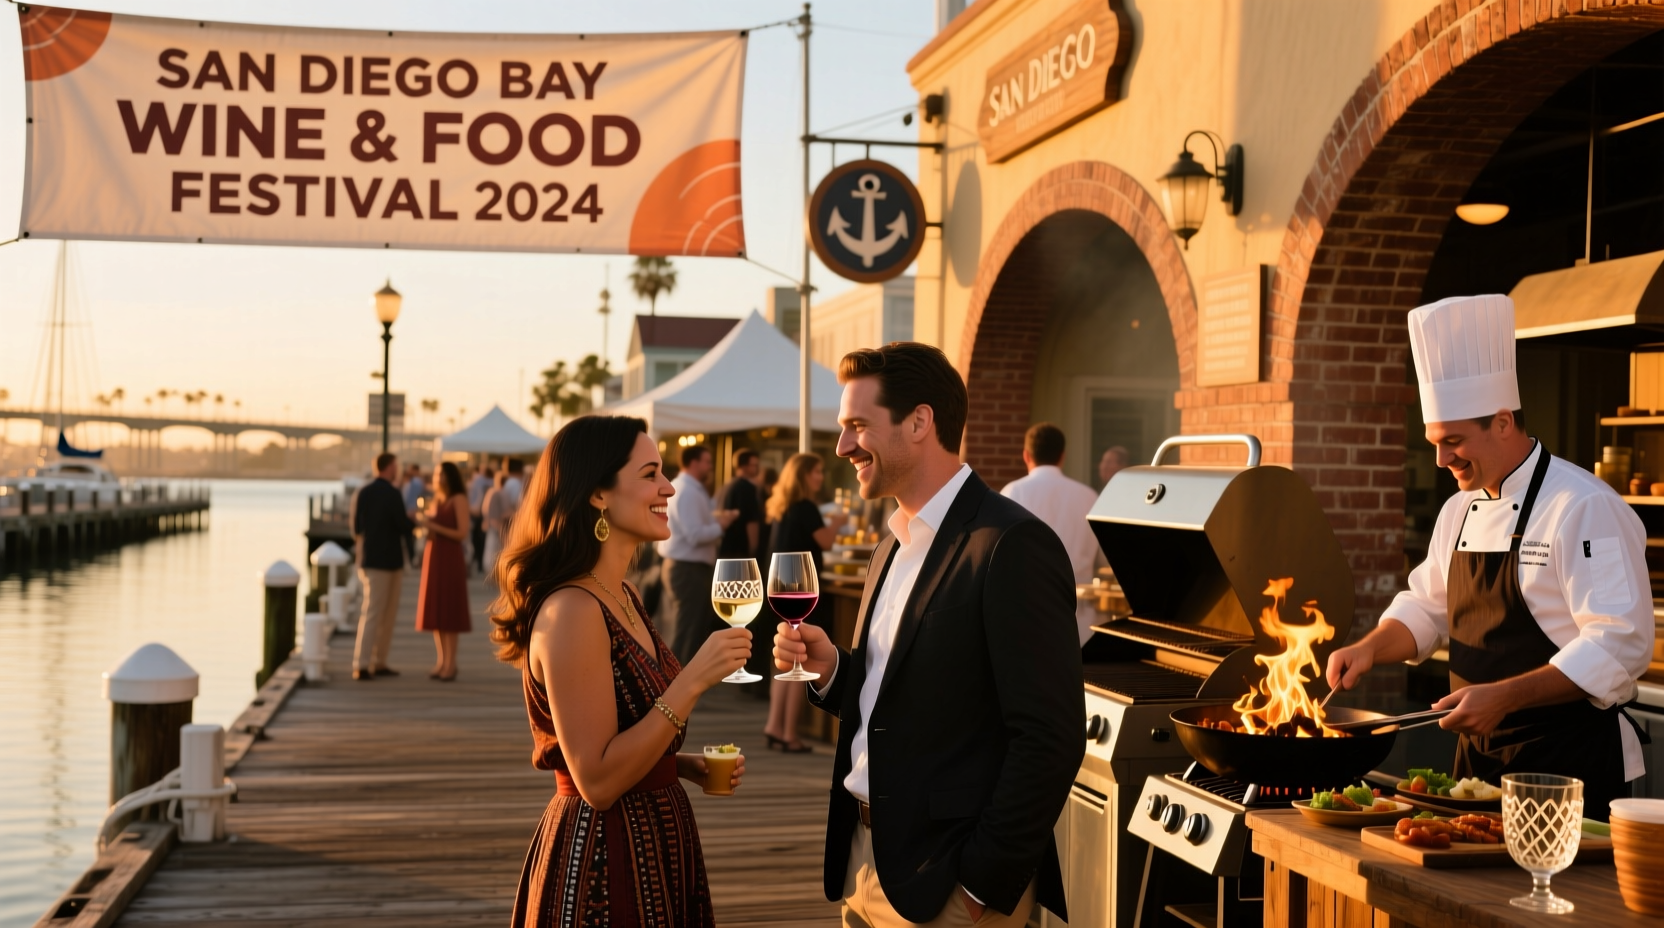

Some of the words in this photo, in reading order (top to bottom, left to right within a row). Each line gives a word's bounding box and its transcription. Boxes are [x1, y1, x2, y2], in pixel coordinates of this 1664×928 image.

[156, 48, 276, 93] SAN
[300, 54, 479, 98] DIEGO
[500, 60, 608, 101] BAY
[989, 72, 1024, 127] SAN
[1028, 23, 1096, 103] DIEGO
[116, 99, 326, 161] WINE
[349, 109, 398, 163] &
[422, 111, 642, 167] FOOD
[171, 170, 459, 221] FESTIVAL
[474, 180, 604, 224] 2024
